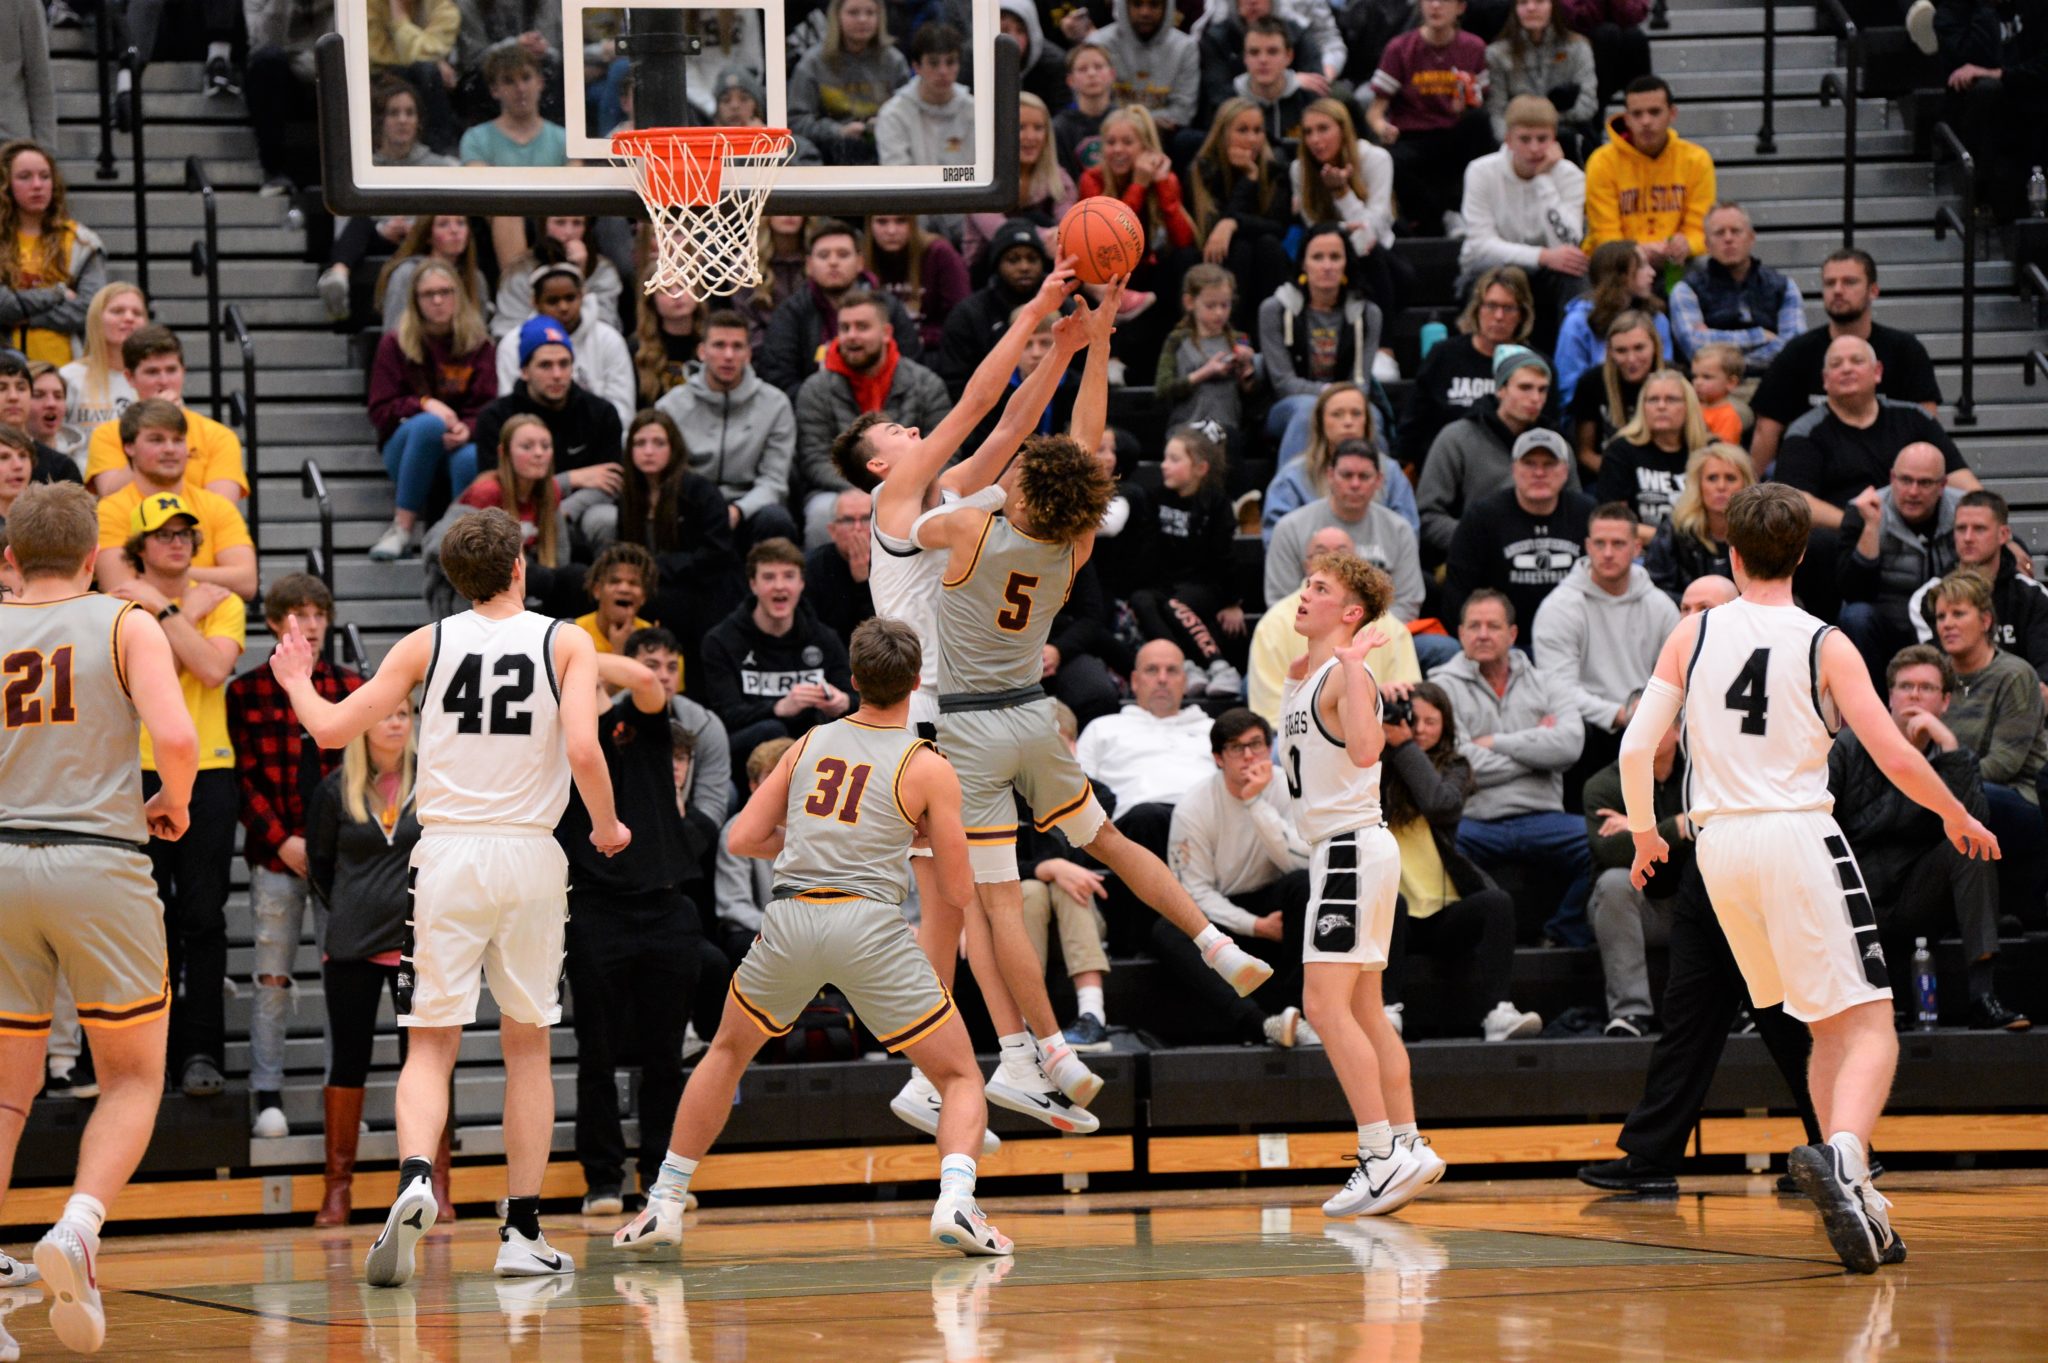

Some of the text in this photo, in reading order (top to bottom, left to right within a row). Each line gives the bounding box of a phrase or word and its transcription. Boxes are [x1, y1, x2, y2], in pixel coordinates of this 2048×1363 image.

[157, 498, 181, 510] M
[994, 569, 1041, 633] 5
[2, 643, 78, 730] 21
[442, 652, 536, 736] 42
[1724, 647, 1772, 737] 4
[803, 754, 874, 826] 31
